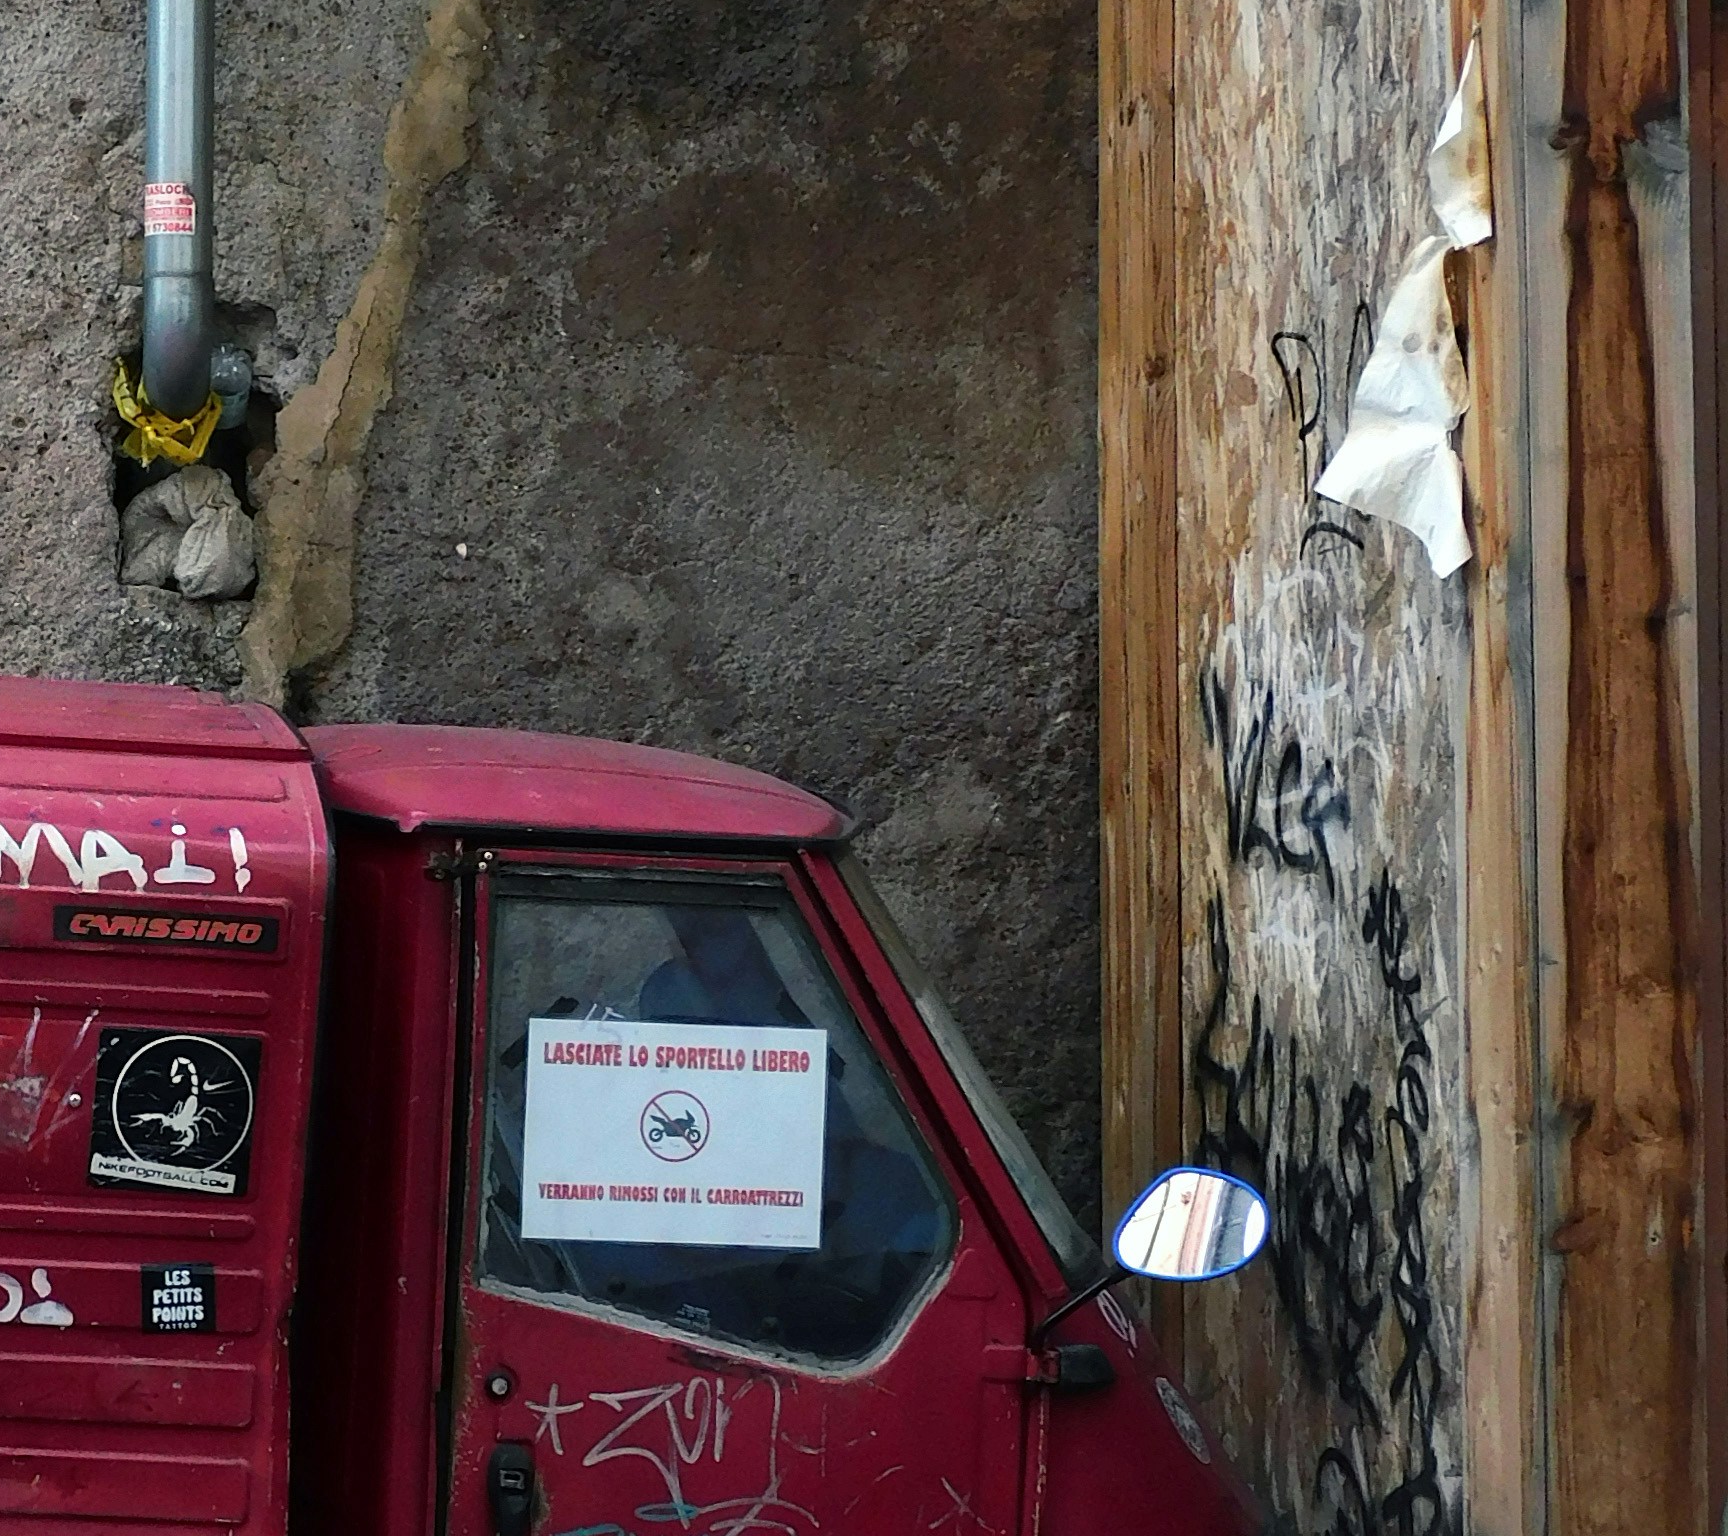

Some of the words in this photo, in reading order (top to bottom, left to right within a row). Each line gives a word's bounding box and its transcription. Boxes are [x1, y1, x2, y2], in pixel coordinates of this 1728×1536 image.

[69, 913, 263, 944] CARISSIMO
[544, 1042, 622, 1066] LASCIATE
[629, 1045, 649, 1067] LO
[655, 1046, 746, 1071] SPORTELLO
[752, 1049, 811, 1073] LIBERO
[538, 1183, 604, 1201] VERRANNO
[609, 1185, 658, 1203] RIMOSSI
[663, 1187, 686, 1204] CON
[690, 1188, 702, 1204] IL
[706, 1188, 804, 1207] CARROATTREZZI
[164, 1270, 191, 1286] LES
[152, 1287, 203, 1305] PETITS
[152, 1305, 204, 1323] POINTS
[159, 1322, 197, 1330] TATTOO
